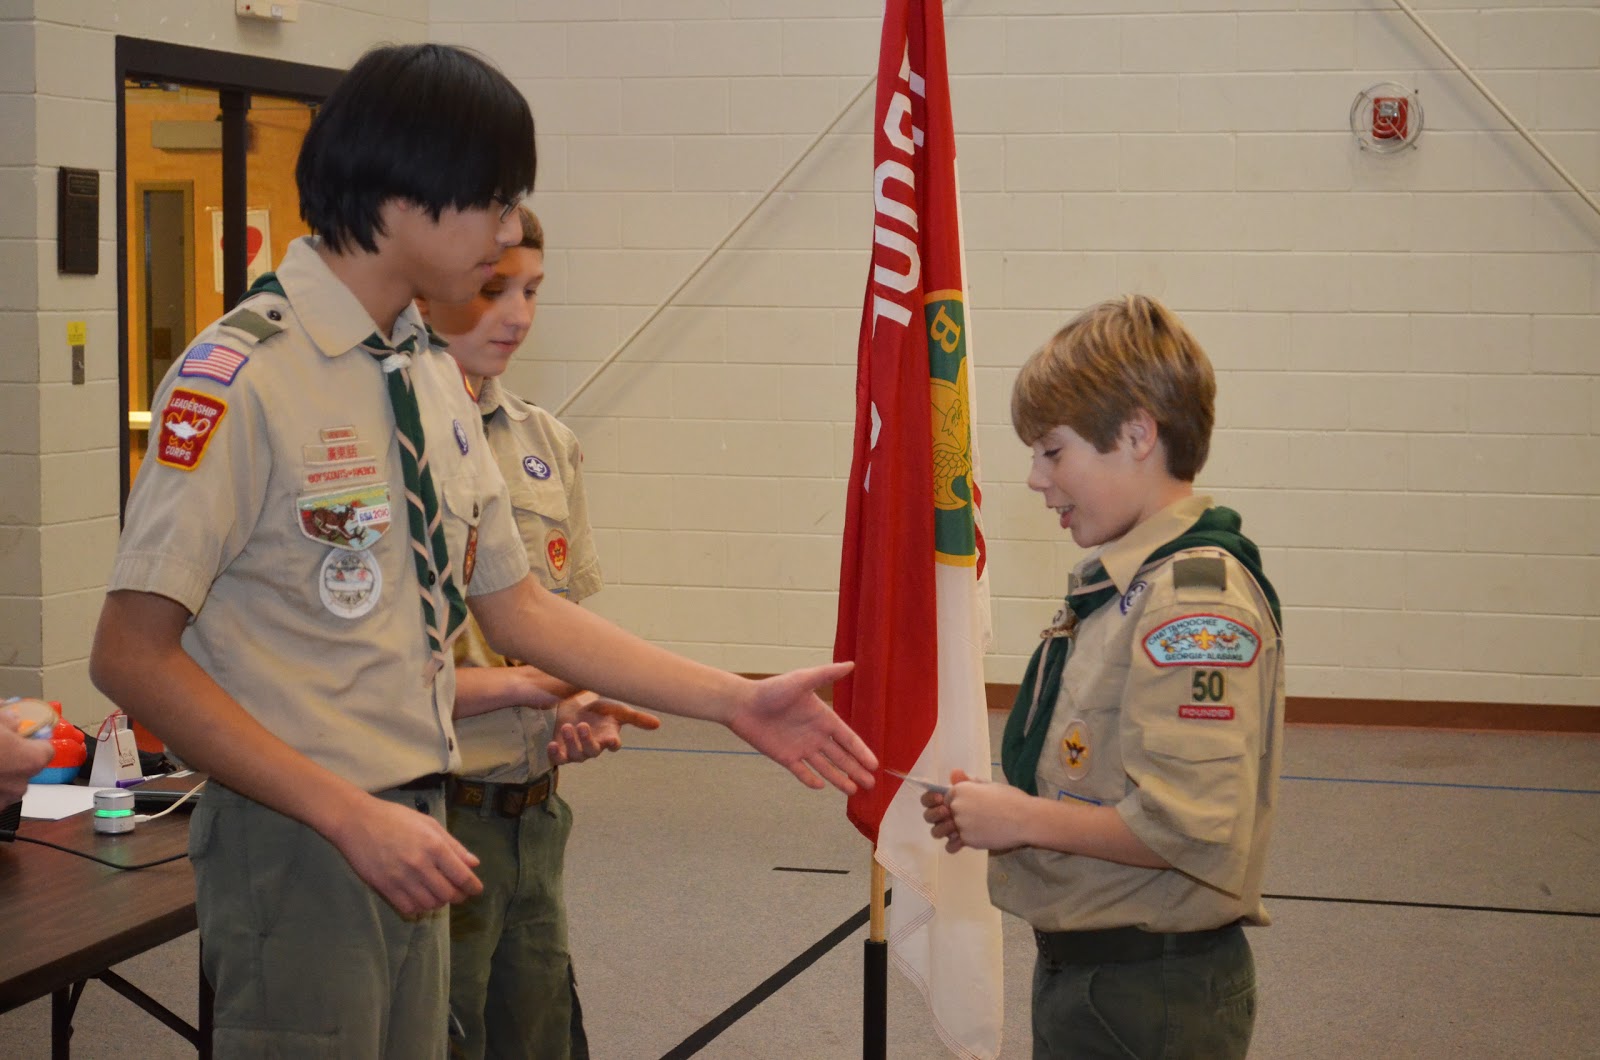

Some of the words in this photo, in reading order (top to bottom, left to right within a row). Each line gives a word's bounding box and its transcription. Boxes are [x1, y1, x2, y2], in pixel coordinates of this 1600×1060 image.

[170, 397, 218, 417] LEADERSHIP
[165, 445, 192, 461] CORPS
[1148, 618, 1218, 645] CHATTAHOOCHEE
[1192, 670, 1225, 702] 50
[1181, 707, 1231, 717] FOUNDER
